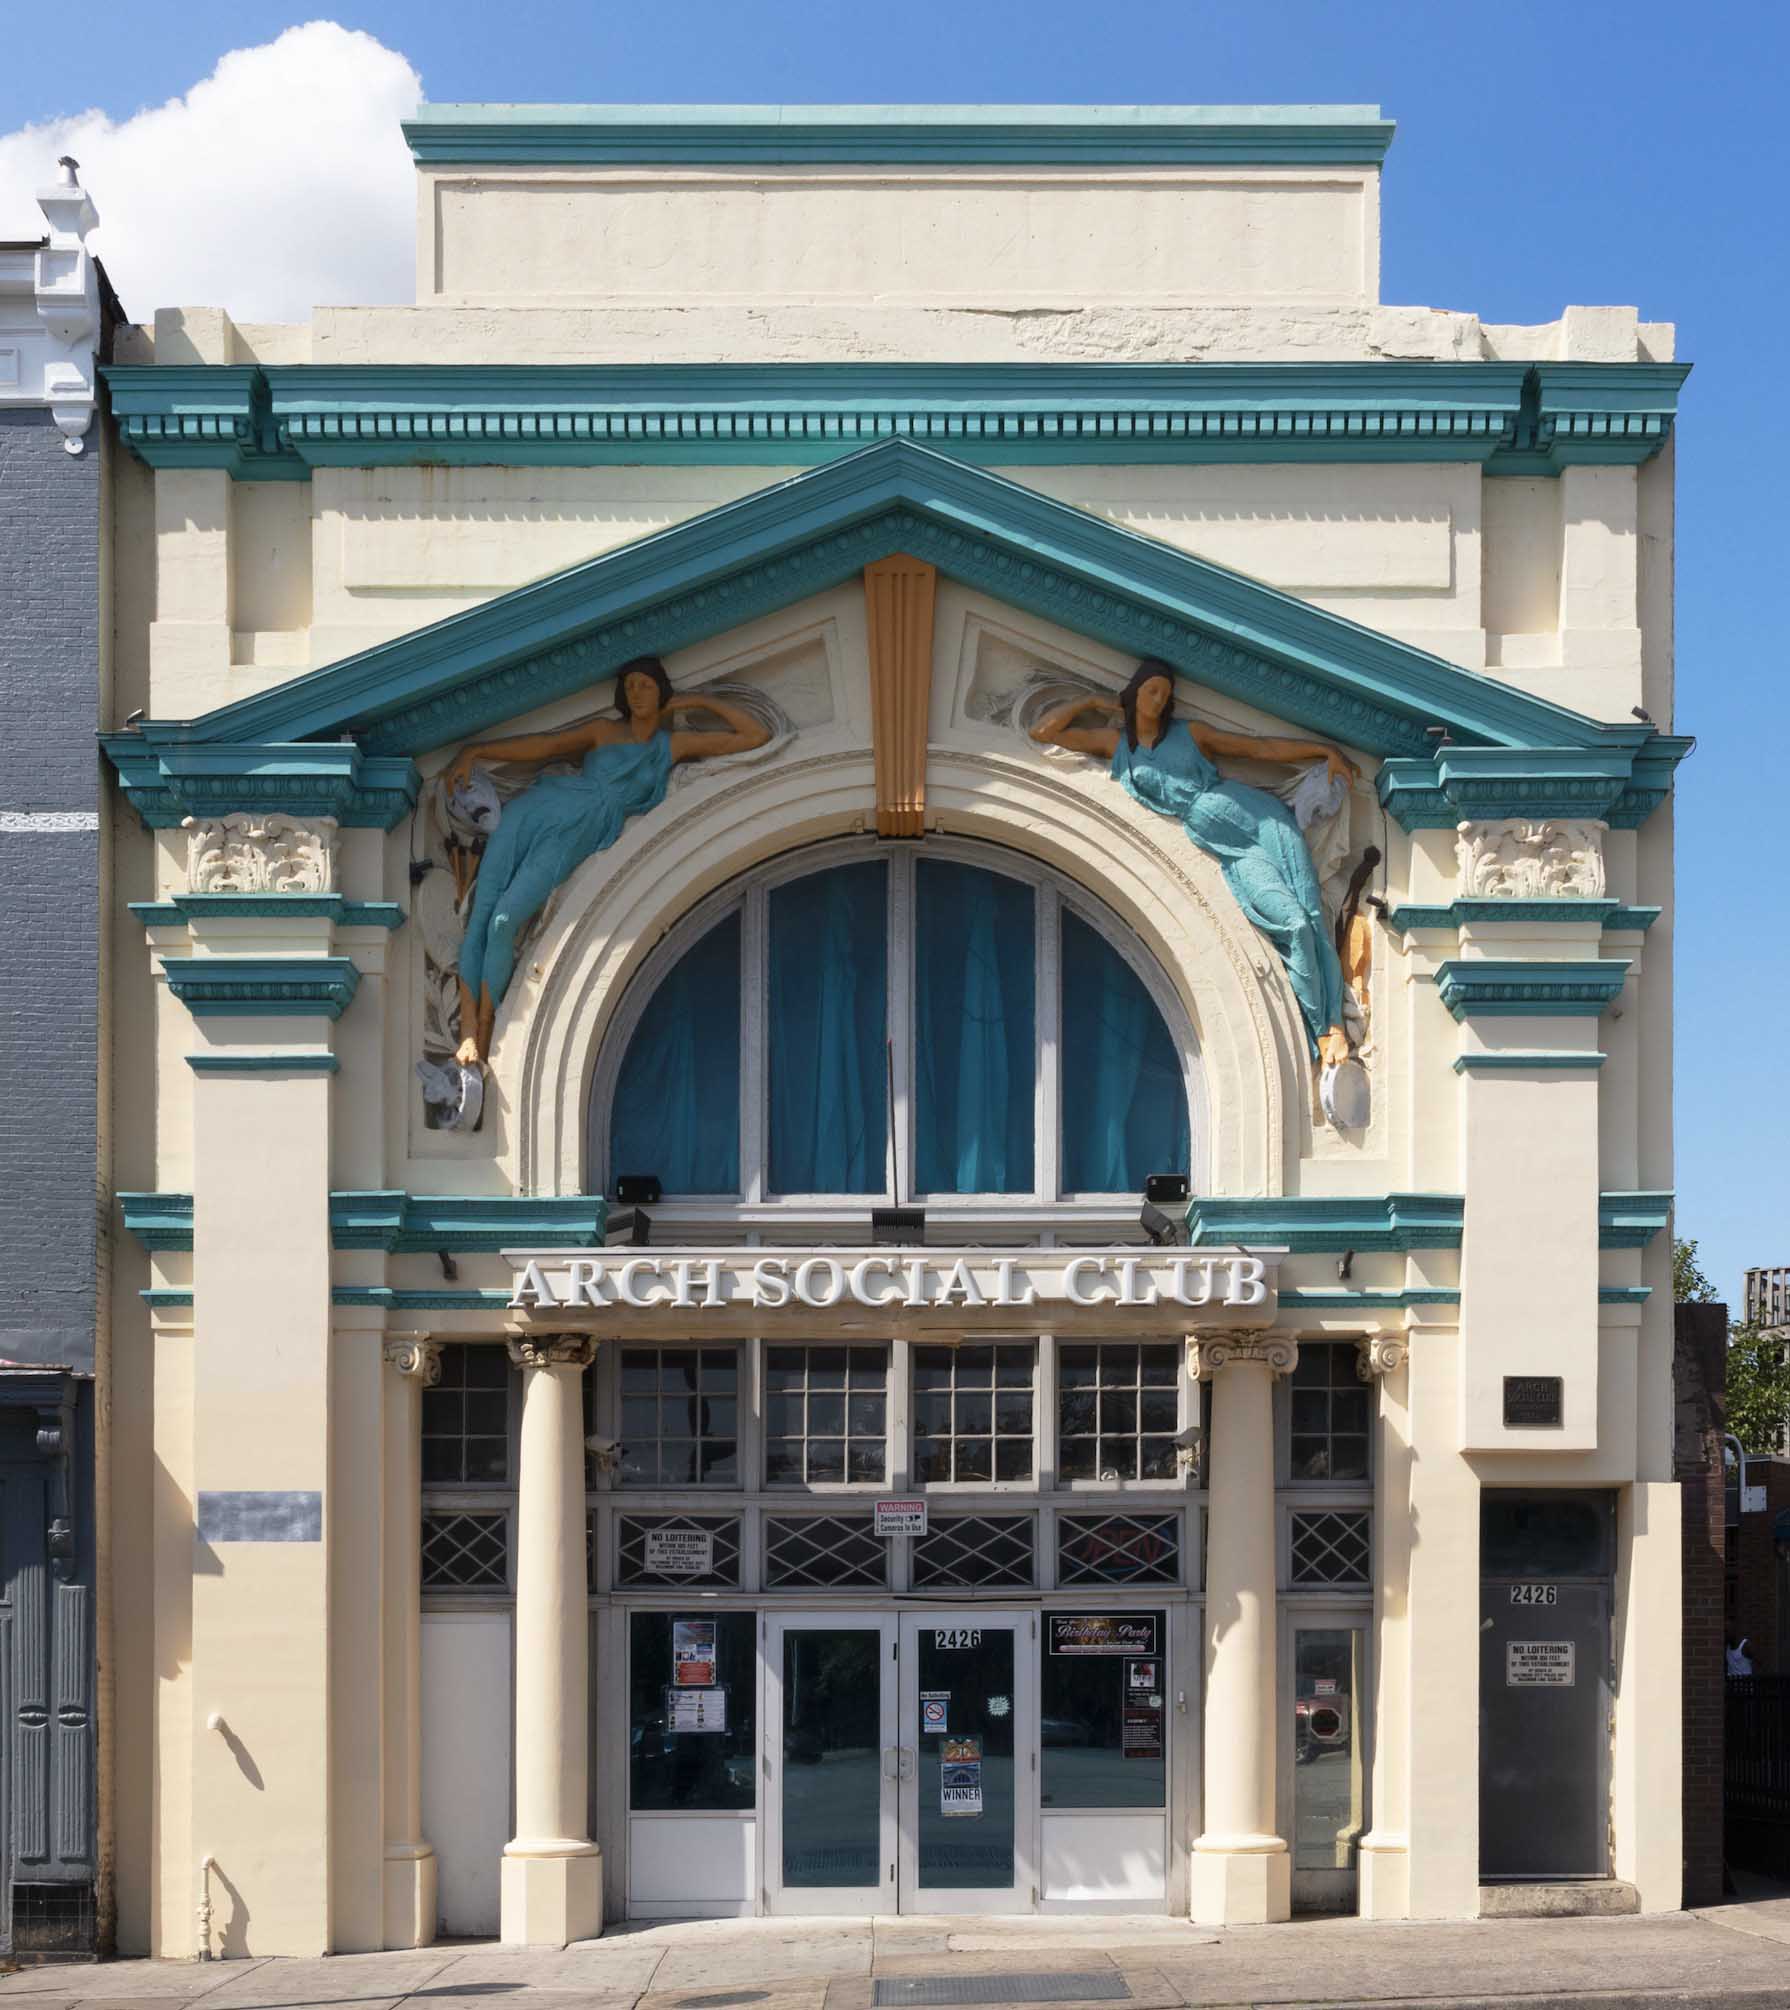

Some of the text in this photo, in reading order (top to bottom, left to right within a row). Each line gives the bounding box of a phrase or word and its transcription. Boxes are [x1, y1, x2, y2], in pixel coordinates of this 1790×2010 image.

[506, 1257, 1268, 1309] ARCH SOCIAL CLUB
[879, 1503, 923, 1512] WARNING
[880, 1514, 904, 1524] Security
[880, 1523, 904, 1531] Cameras
[651, 1533, 707, 1542] NO LOITERING
[1512, 1585, 1555, 1604] 2426
[1116, 1624, 1152, 1639] Party
[937, 1630, 982, 1648] 2426
[1513, 1646, 1568, 1654] NO LOITERING
[944, 1788, 980, 1801] WINNER
